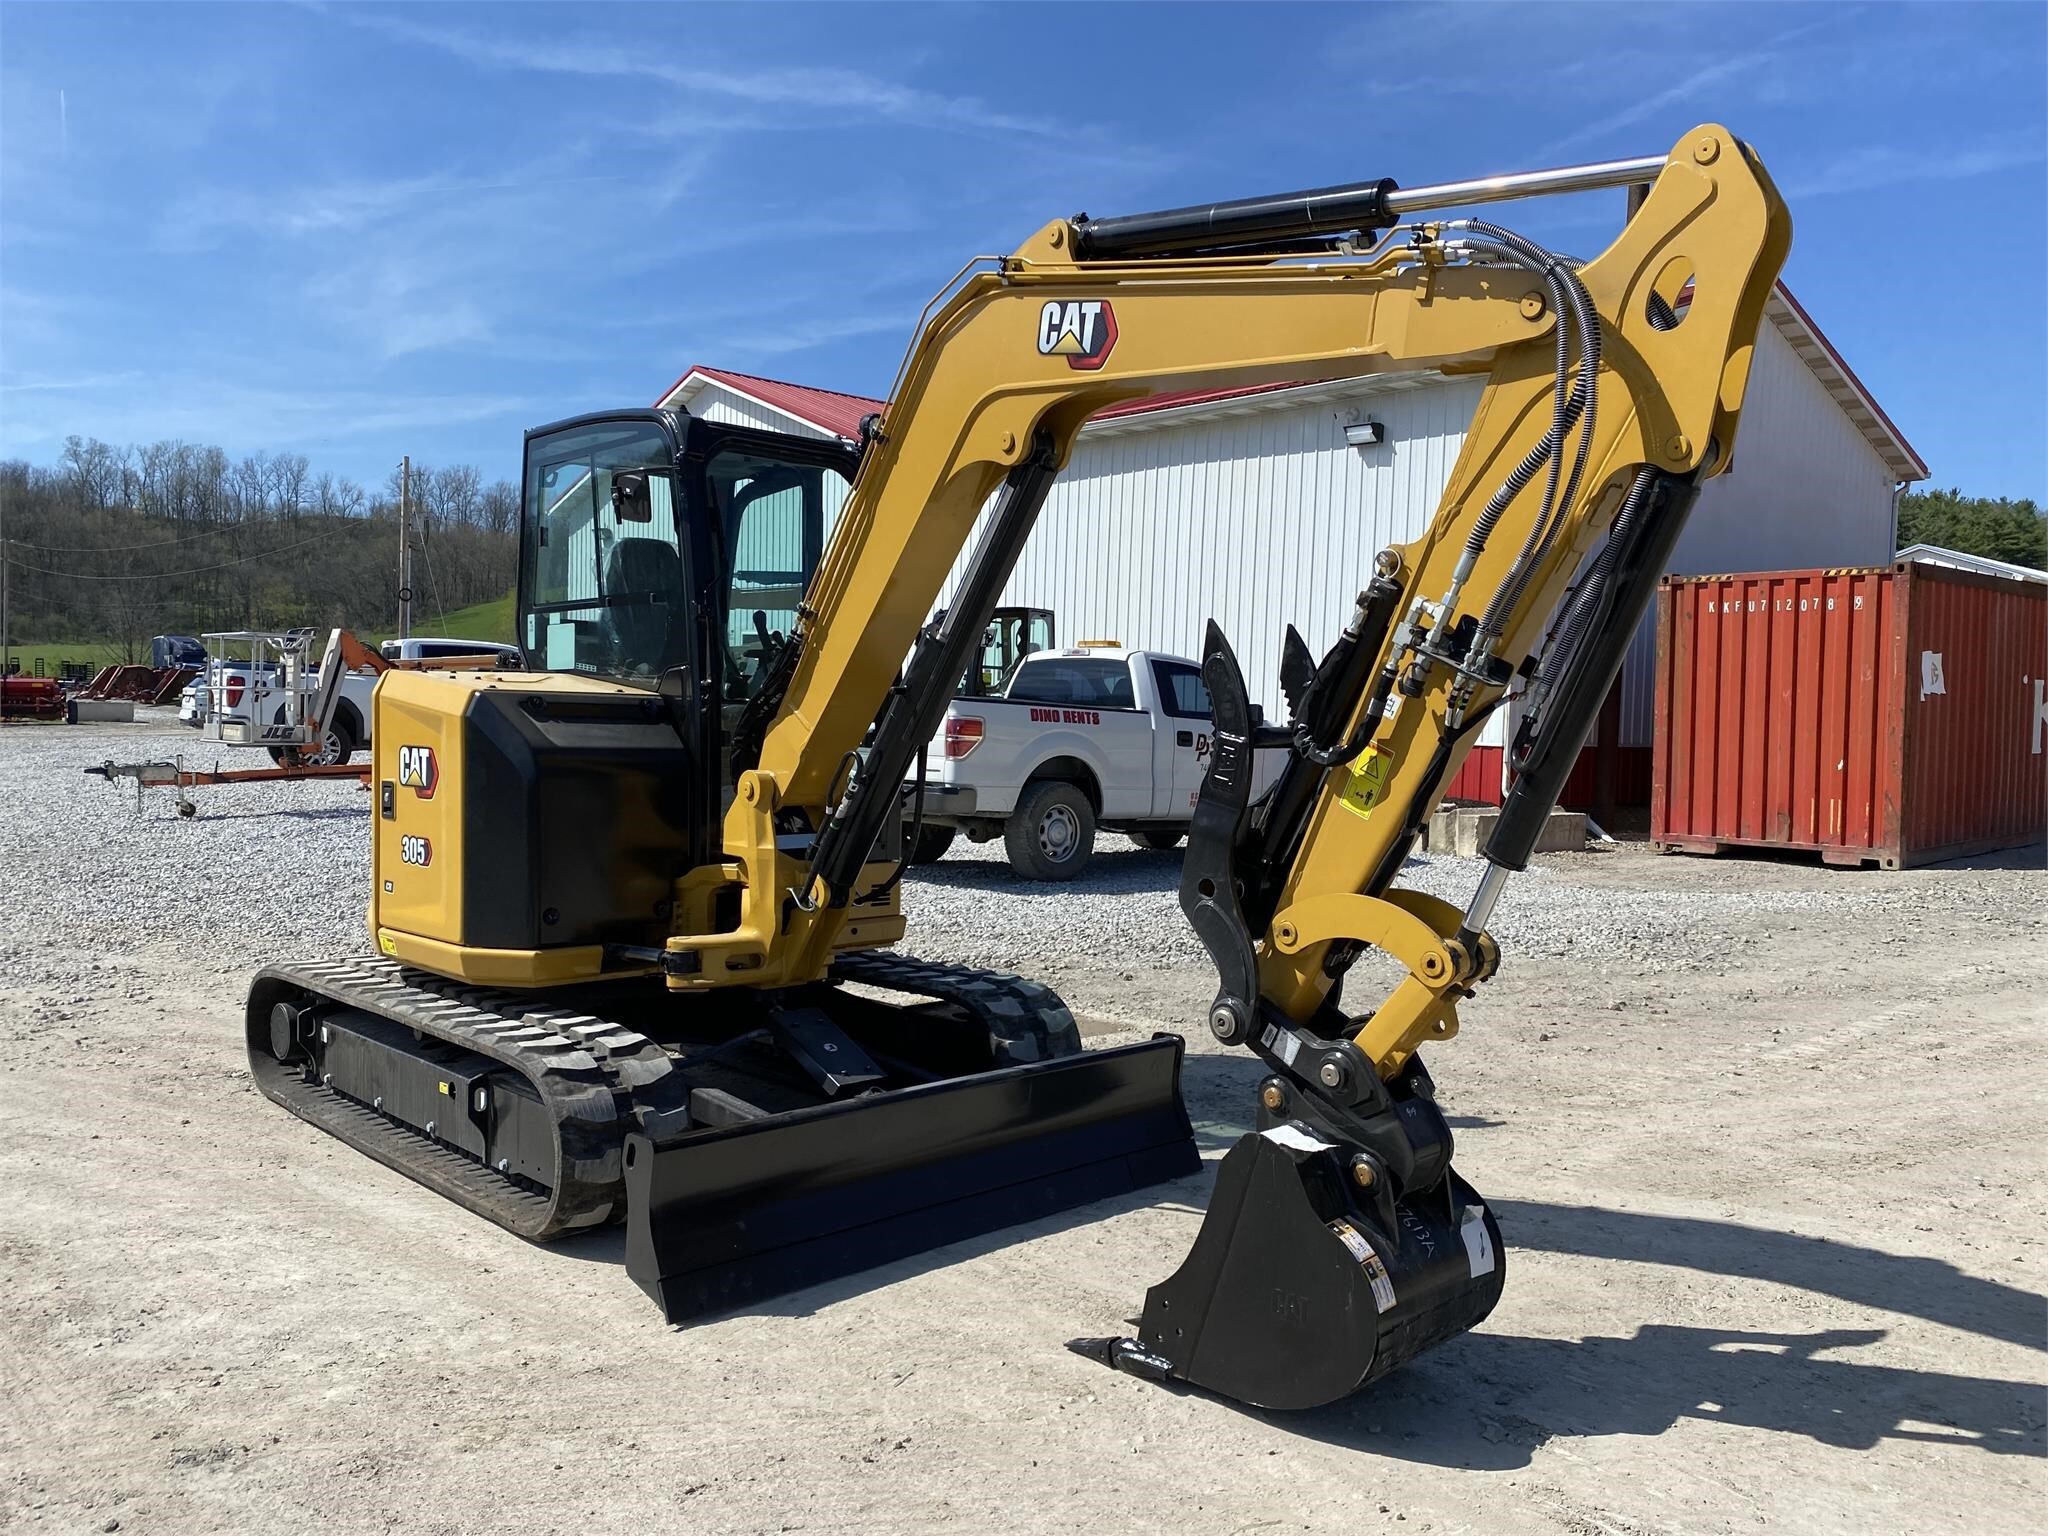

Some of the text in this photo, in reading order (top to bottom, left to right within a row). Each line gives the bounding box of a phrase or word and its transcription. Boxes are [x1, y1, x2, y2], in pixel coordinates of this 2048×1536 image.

[1039, 301, 1101, 354] CAT
[1030, 708, 1100, 725] DINO RENTS
[261, 727, 295, 739] JLG
[400, 746, 429, 786] CAT
[402, 836, 424, 865] 305
